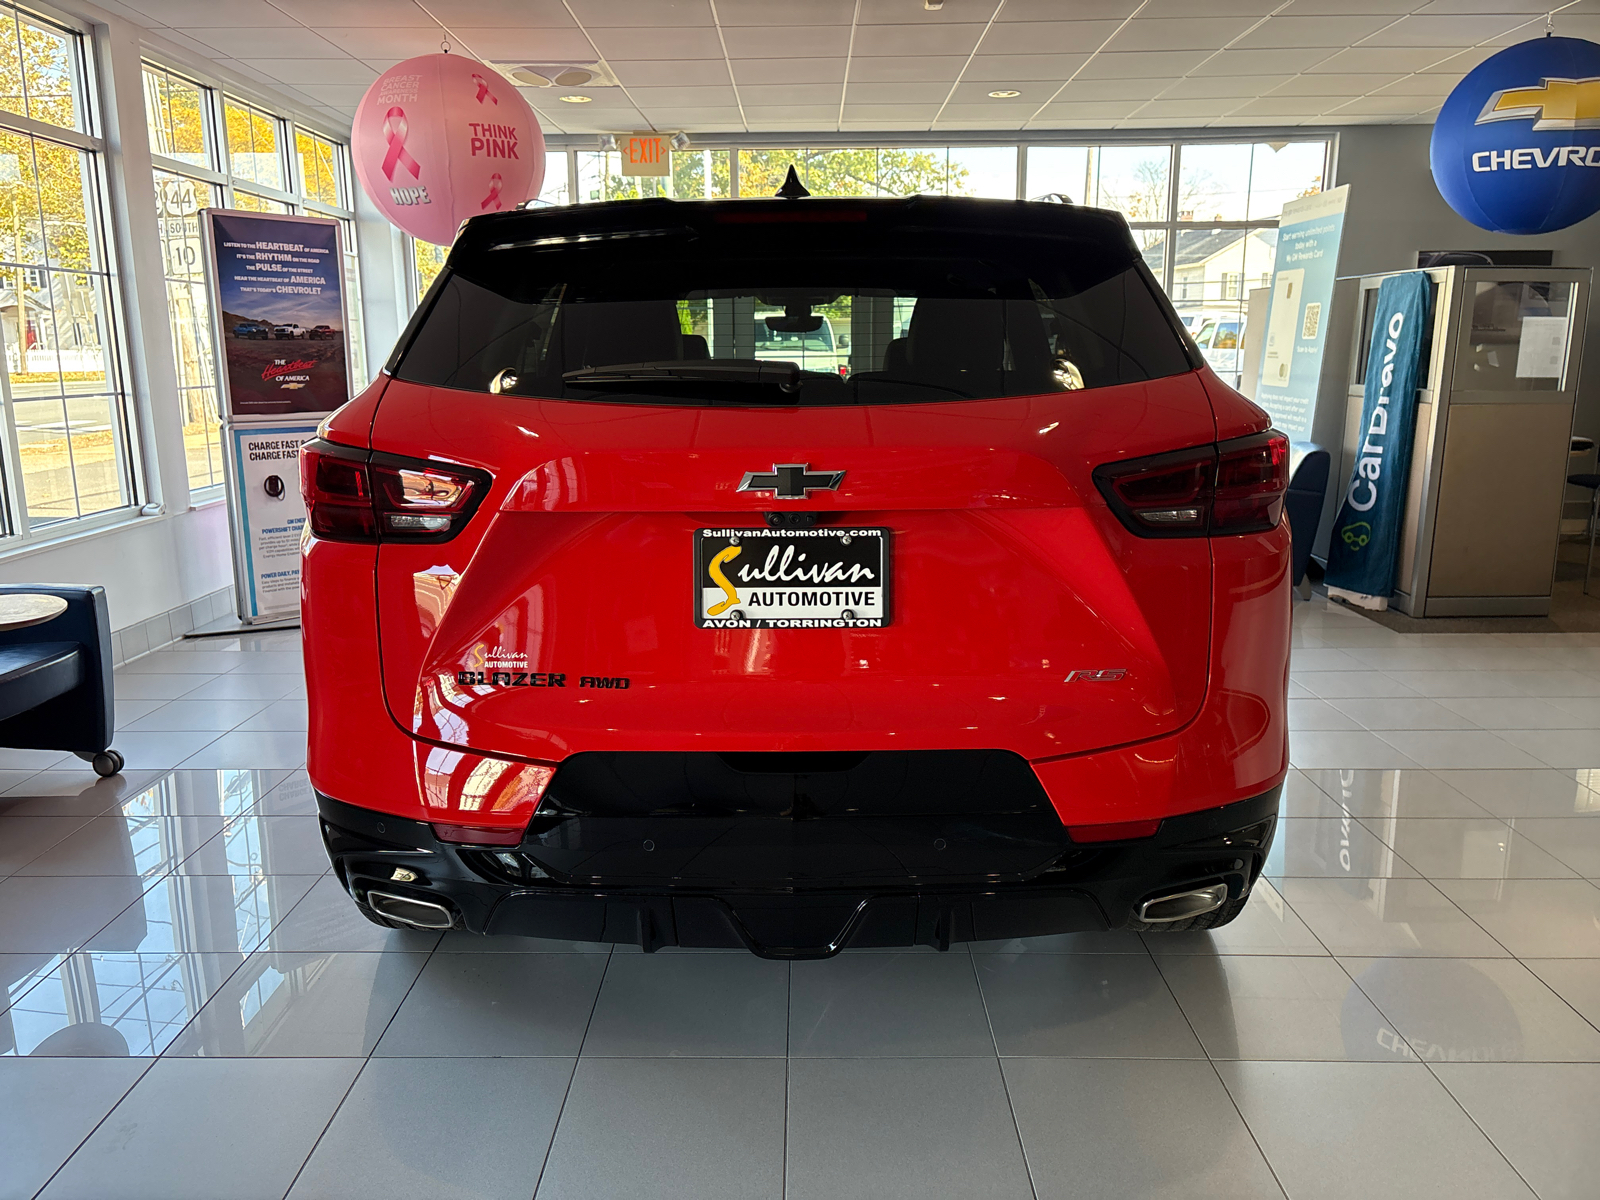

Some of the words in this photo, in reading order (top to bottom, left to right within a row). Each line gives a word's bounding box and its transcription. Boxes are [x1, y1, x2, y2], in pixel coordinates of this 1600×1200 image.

[382, 74, 423, 86] BREAST
[380, 81, 420, 92] CANCER
[376, 93, 418, 106] MONTH
[468, 122, 518, 142] THINK
[470, 137, 520, 160] PINK
[629, 137, 662, 164] EXIT
[170, 188, 192, 209] 44
[389, 185, 432, 207] HOPE
[255, 241, 304, 252] HEARTBEAT
[175, 245, 196, 266] 10
[255, 252, 292, 262] RHYTHM
[255, 263, 283, 272] PULSE
[290, 275, 326, 285] AMERICA
[275, 285, 322, 295] CHEVROLET
[261, 359, 318, 380] Heartbeat
[248, 441, 280, 451] CHARGE
[281, 440, 300, 449] FAST
[249, 451, 281, 461] CHARGE
[282, 449, 300, 459] FAST
[261, 526, 291, 535] POWERSHIFT
[702, 528, 882, 538] SullivanAutomotive.com
[707, 544, 876, 617] Sullivan
[748, 591, 875, 607] AUTOMOTIVE
[702, 619, 752, 628] AVON
[766, 619, 882, 628] TORRINGTON
[474, 644, 529, 668] Sullivan
[484, 661, 529, 669] AUTOMOTIVE
[457, 671, 567, 688] BLAZER
[579, 676, 631, 690] AWD
[1063, 668, 1127, 683] RS
